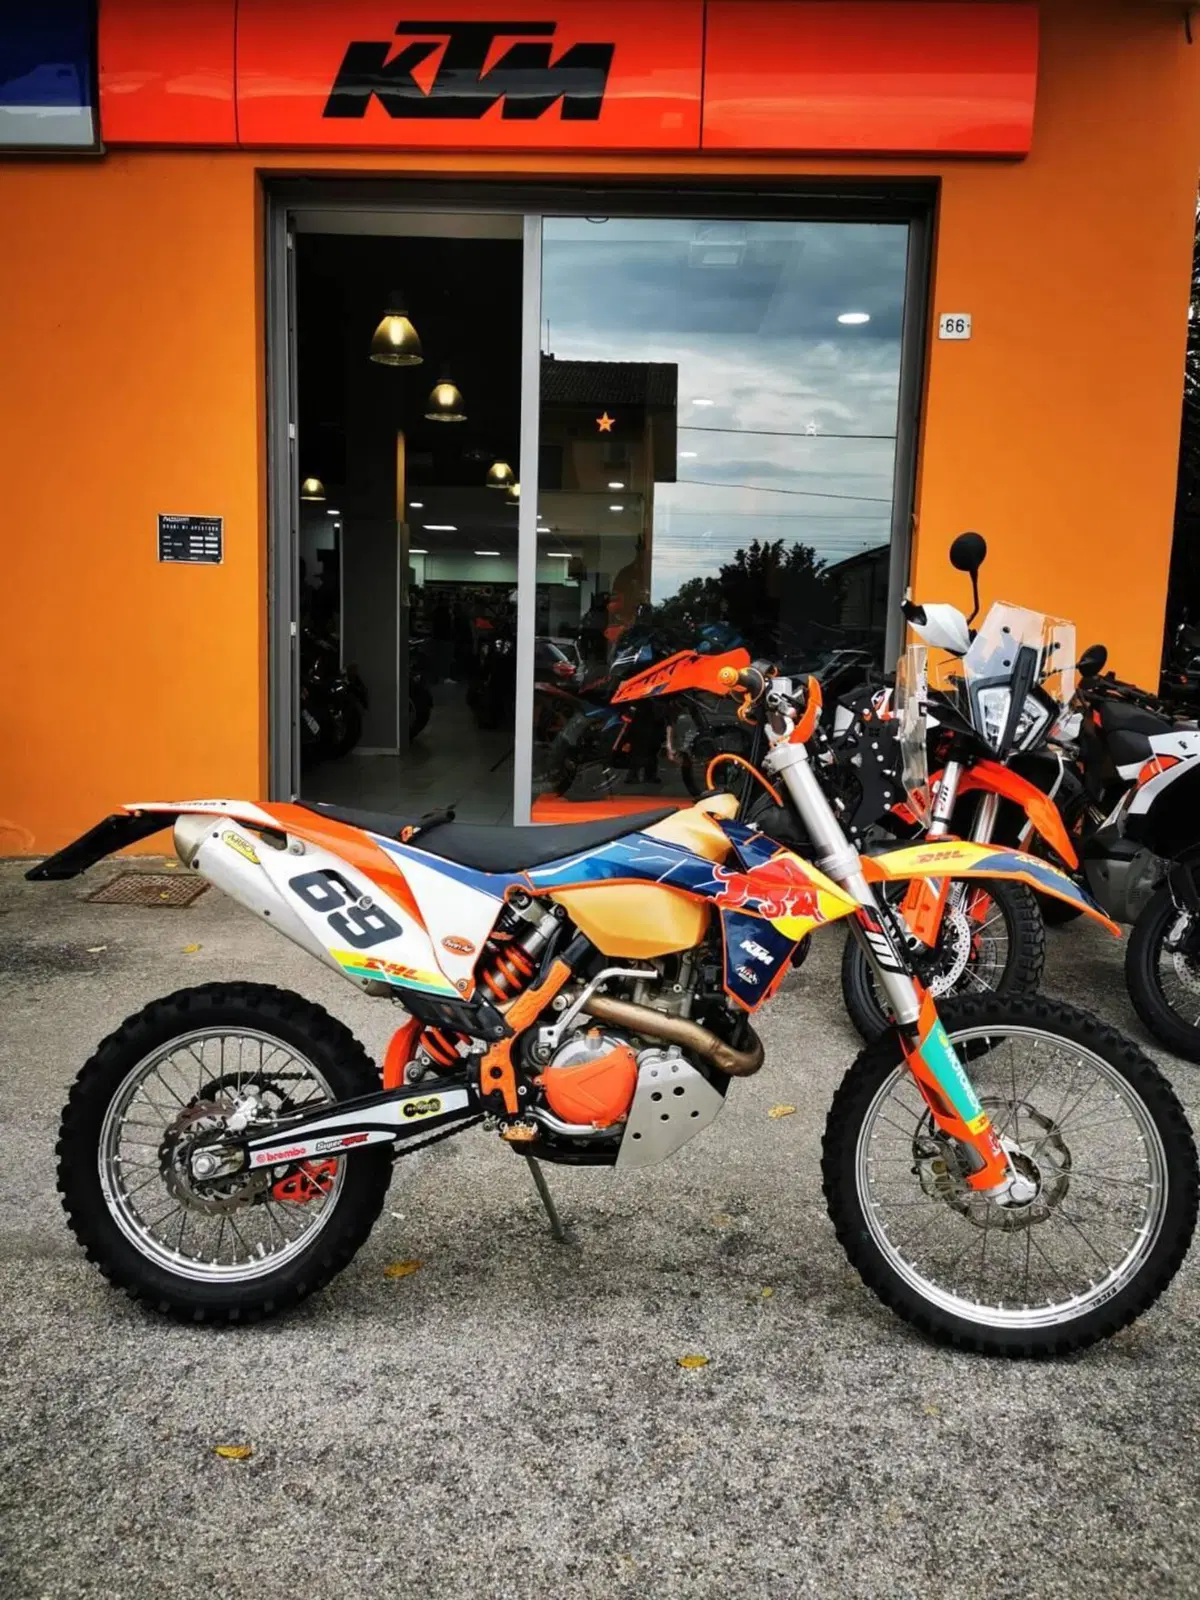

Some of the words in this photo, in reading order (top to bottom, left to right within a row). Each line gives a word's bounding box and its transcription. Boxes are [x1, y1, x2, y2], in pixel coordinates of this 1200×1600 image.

[322, 21, 616, 120] KTM
[945, 318, 965, 333] 66
[289, 869, 403, 949] 69
[740, 940, 774, 965] KTM
[364, 957, 419, 981] DHL
[945, 1046, 983, 1115] MOTOREX
[266, 1147, 306, 1162] brembo
